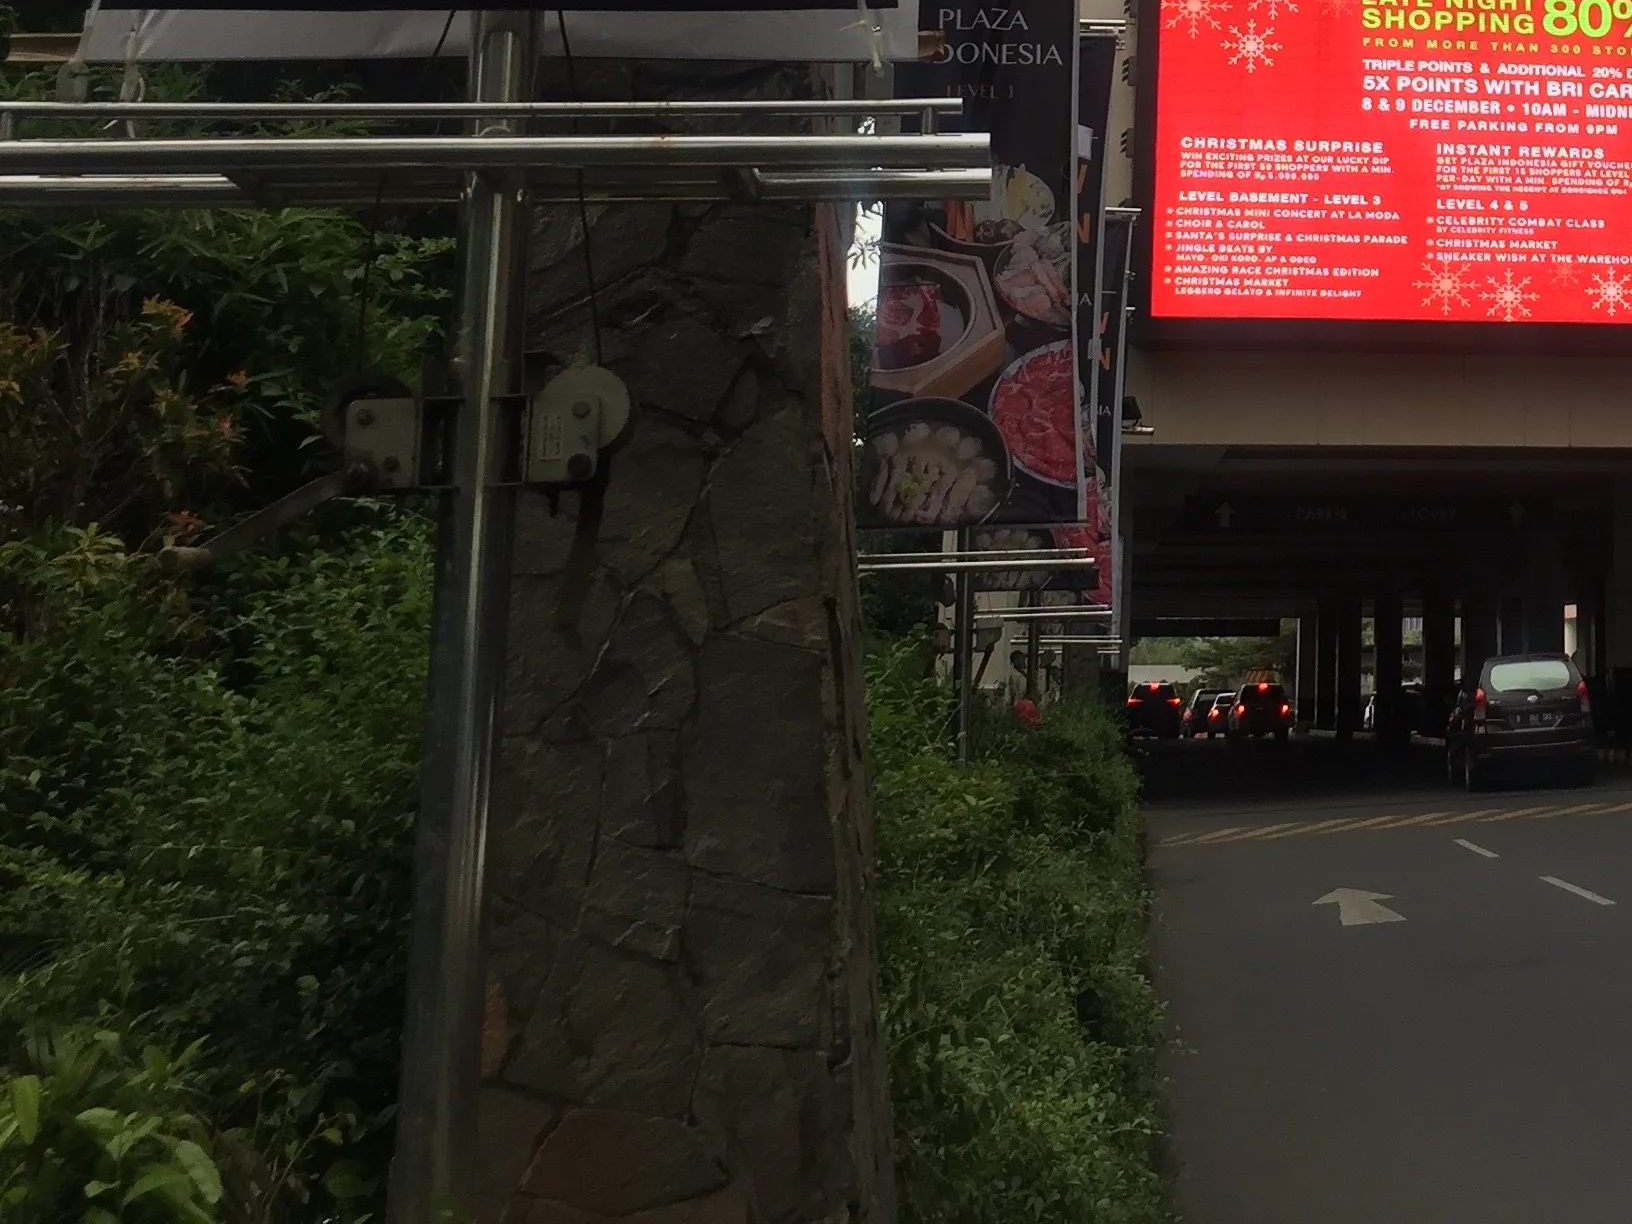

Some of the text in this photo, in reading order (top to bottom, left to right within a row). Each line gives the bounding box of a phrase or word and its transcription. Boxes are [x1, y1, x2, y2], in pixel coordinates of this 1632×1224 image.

[939, 8, 1028, 31] PLAZA
[1362, 9, 1534, 34] SHOPPING
[1362, 38, 1414, 49] FROM
[1426, 40, 1478, 51] MORE
[1490, 42, 1539, 53] THAN
[1550, 44, 1581, 54] 300
[1362, 59, 1415, 72] TRIPLE
[1417, 61, 1473, 74] POINTS
[1479, 63, 1490, 74] &
[1497, 63, 1586, 77] ADDITIONAL
[1592, 66, 1623, 78] 20%
[1363, 76, 1390, 91] 5X
[1396, 77, 1479, 94] POINTS
[1484, 79, 1540, 96] WITH
[1546, 81, 1583, 97] BRI
[1361, 98, 1373, 111] 8
[1377, 99, 1390, 111] &
[1395, 99, 1406, 112] 9
[1411, 100, 1501, 114] DECEMBER
[1522, 103, 1567, 116] 10AM
[1409, 119, 1450, 130] FREE
[1457, 120, 1528, 132] PARKING
[1535, 122, 1580, 133] FROM
[1180, 137, 1383, 153] CHRISTMAS SURPRISE
[1436, 144, 1605, 159] INSTANT REWARDS
[1179, 191, 1381, 204] LEVEL BASEMENT LEVEL 3
[1436, 199, 1485, 210] LEVEL
[1489, 200, 1499, 210] 4
[1519, 201, 1529, 211] 5
[1175, 207, 1400, 220] CHRISTMAS MINI CONCERT AT LA MODA
[1435, 239, 1557, 249] CHRISTMAS MARKET
